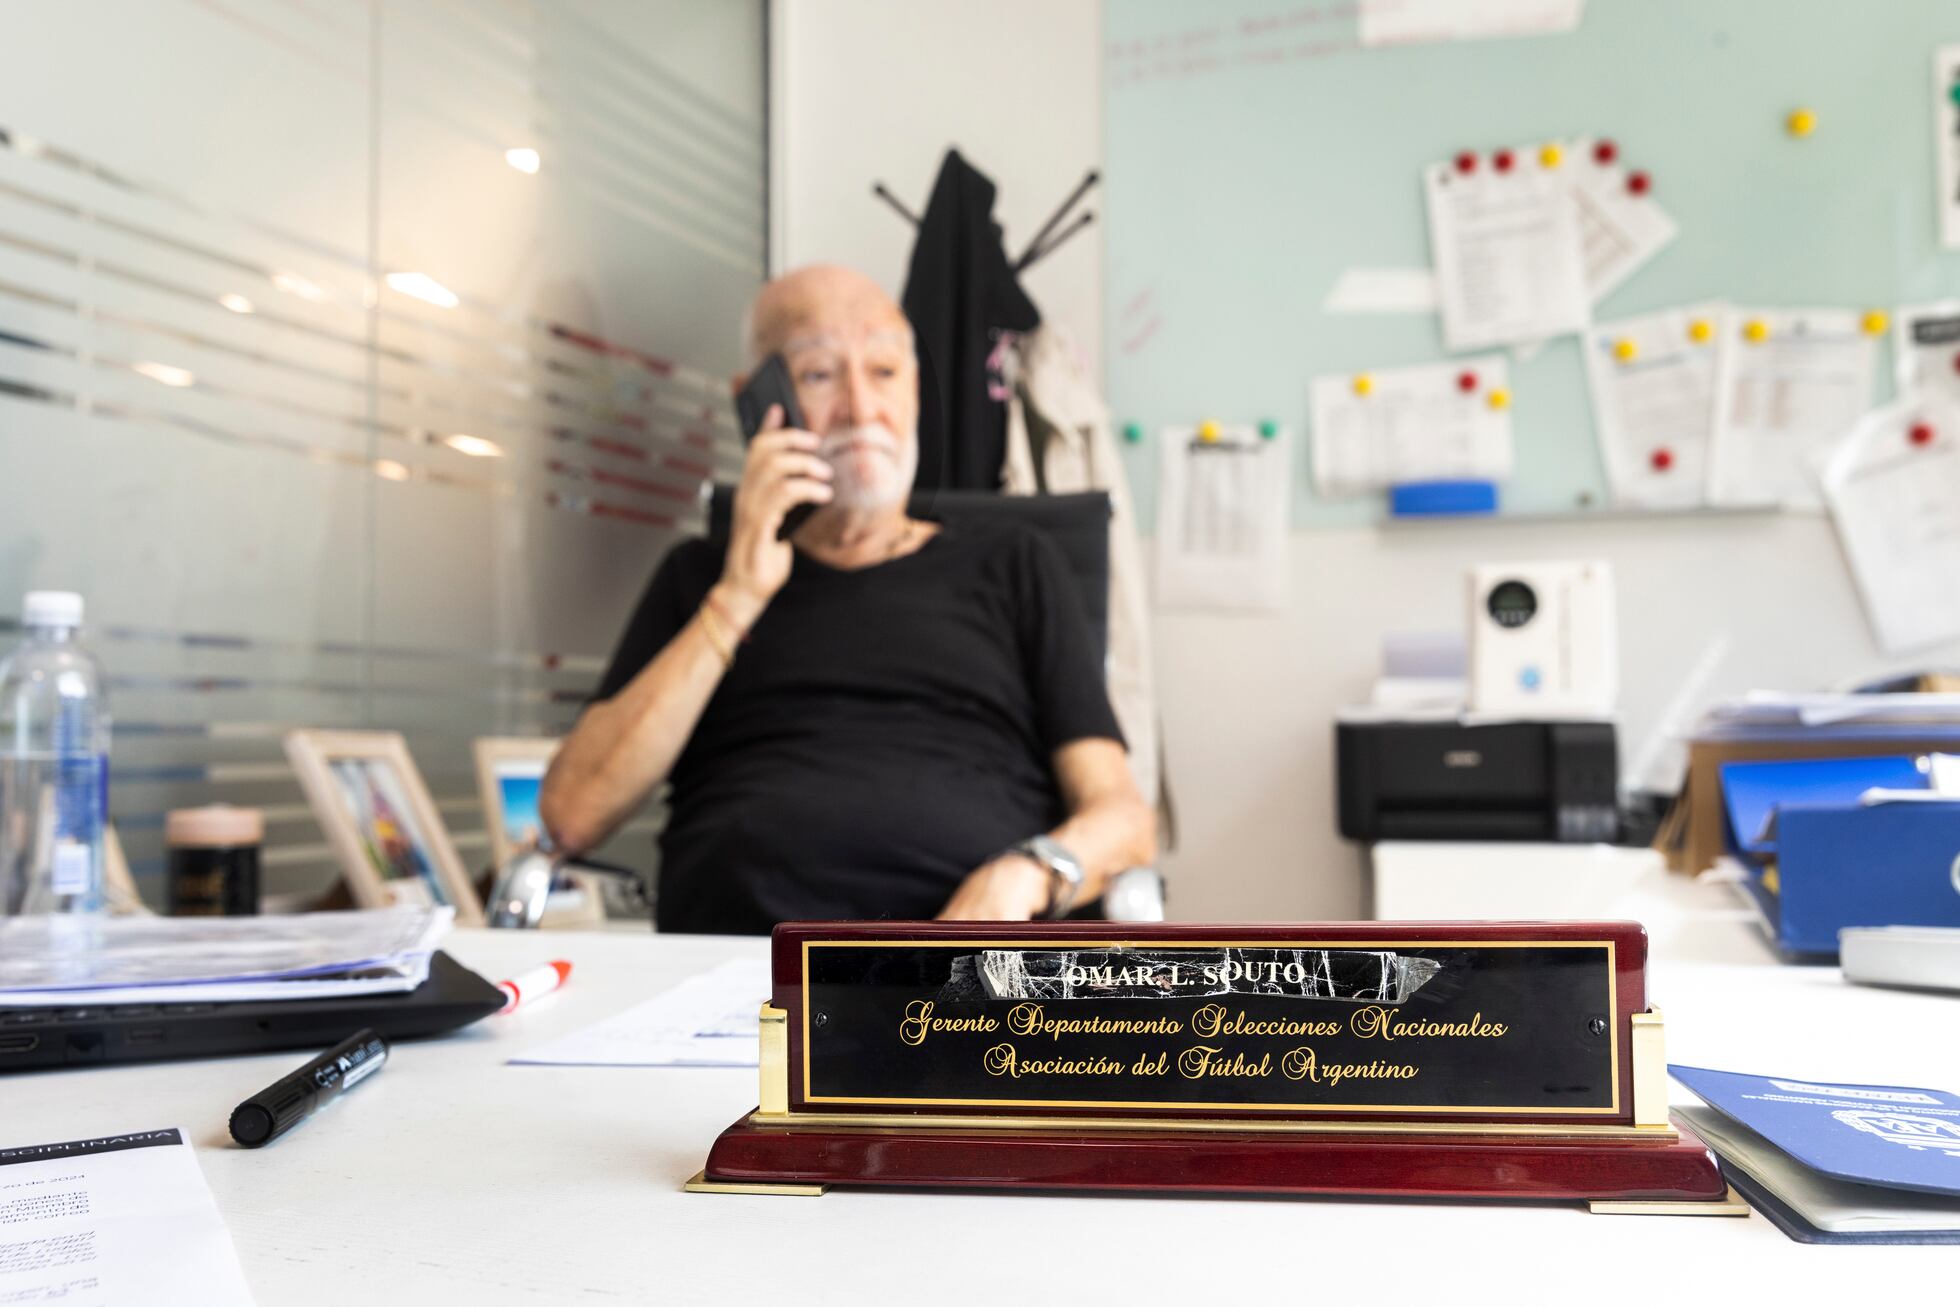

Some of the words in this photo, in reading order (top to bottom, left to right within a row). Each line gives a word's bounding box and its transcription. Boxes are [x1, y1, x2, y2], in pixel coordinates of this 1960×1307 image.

[1067, 966, 1162, 987] OMAR.
[1171, 965, 1196, 986] L.
[899, 1000, 1000, 1046] Gerente
[1007, 1002, 1184, 1040] Departamento
[1191, 1003, 1342, 1038] Selecciones
[1350, 1005, 1509, 1041] Nacionales
[983, 1043, 1126, 1079] Asociación
[1131, 1053, 1170, 1076] del
[1178, 1045, 1274, 1080] Fútbol
[1281, 1046, 1420, 1087] Argentino
